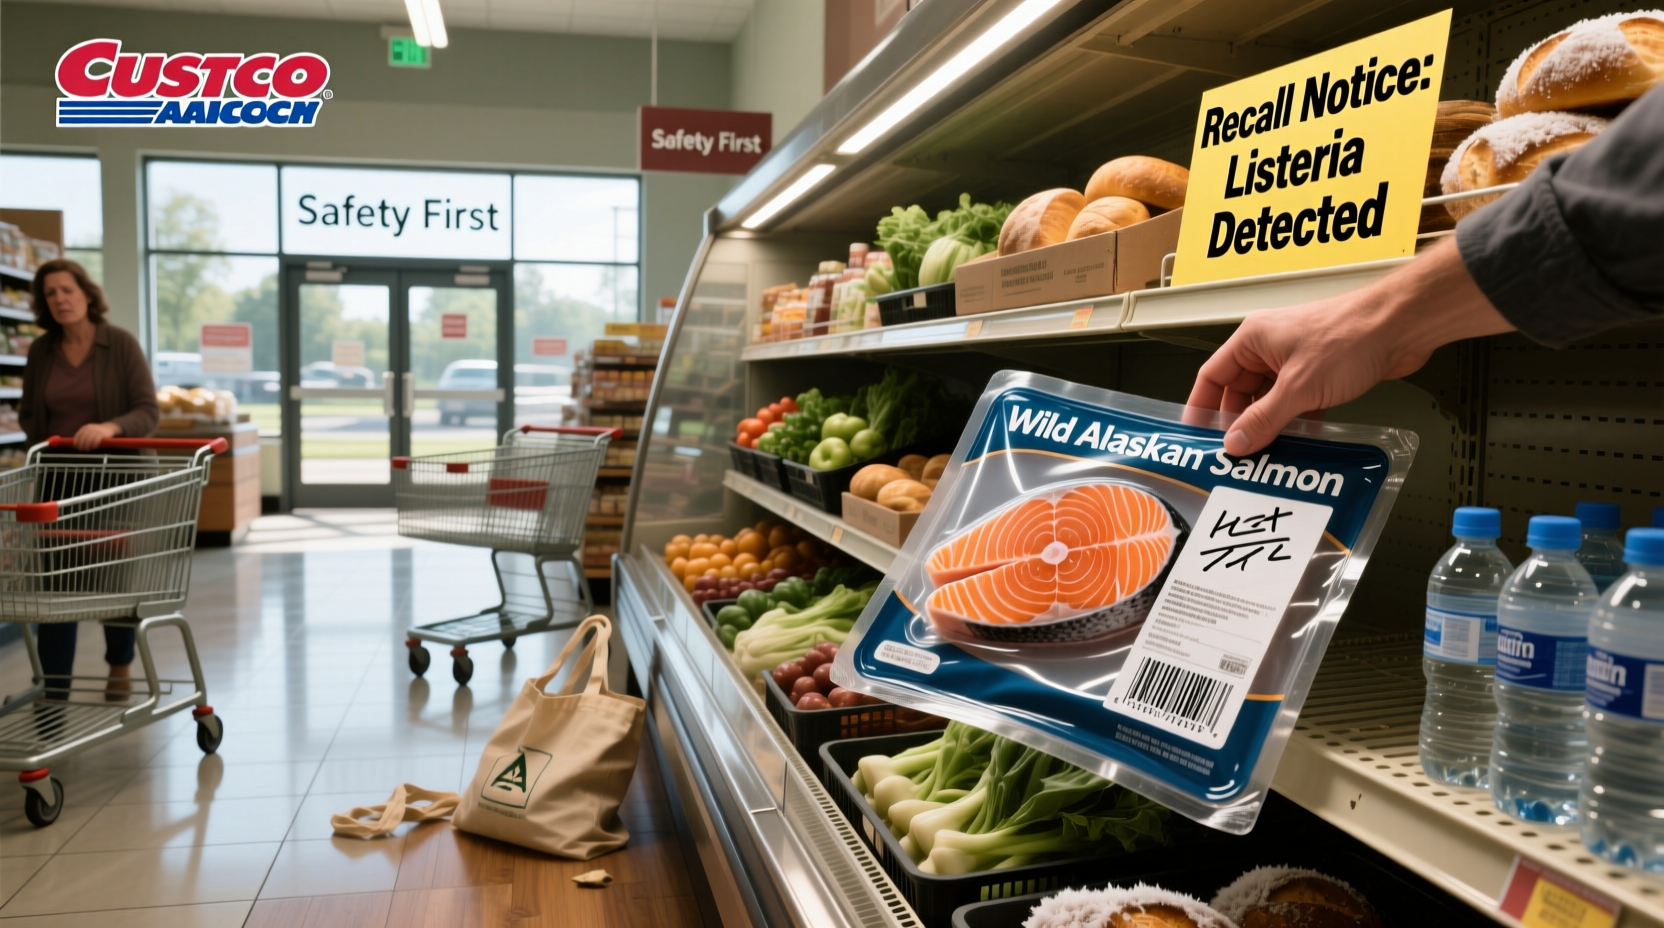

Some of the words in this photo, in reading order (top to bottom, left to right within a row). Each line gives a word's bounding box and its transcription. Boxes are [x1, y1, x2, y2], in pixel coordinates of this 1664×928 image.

[1200, 82, 1296, 149] Recall
[1299, 53, 1434, 123] Notice:
[651, 127, 714, 157] Safety
[718, 131, 762, 154] First
[1223, 127, 1366, 200] Listeria
[299, 194, 411, 237] Safety
[424, 198, 499, 232] First
[1206, 180, 1390, 259] Detected
[1008, 404, 1079, 444] Wild
[1073, 420, 1205, 471] Alaskan
[1209, 447, 1345, 498] Salmon
